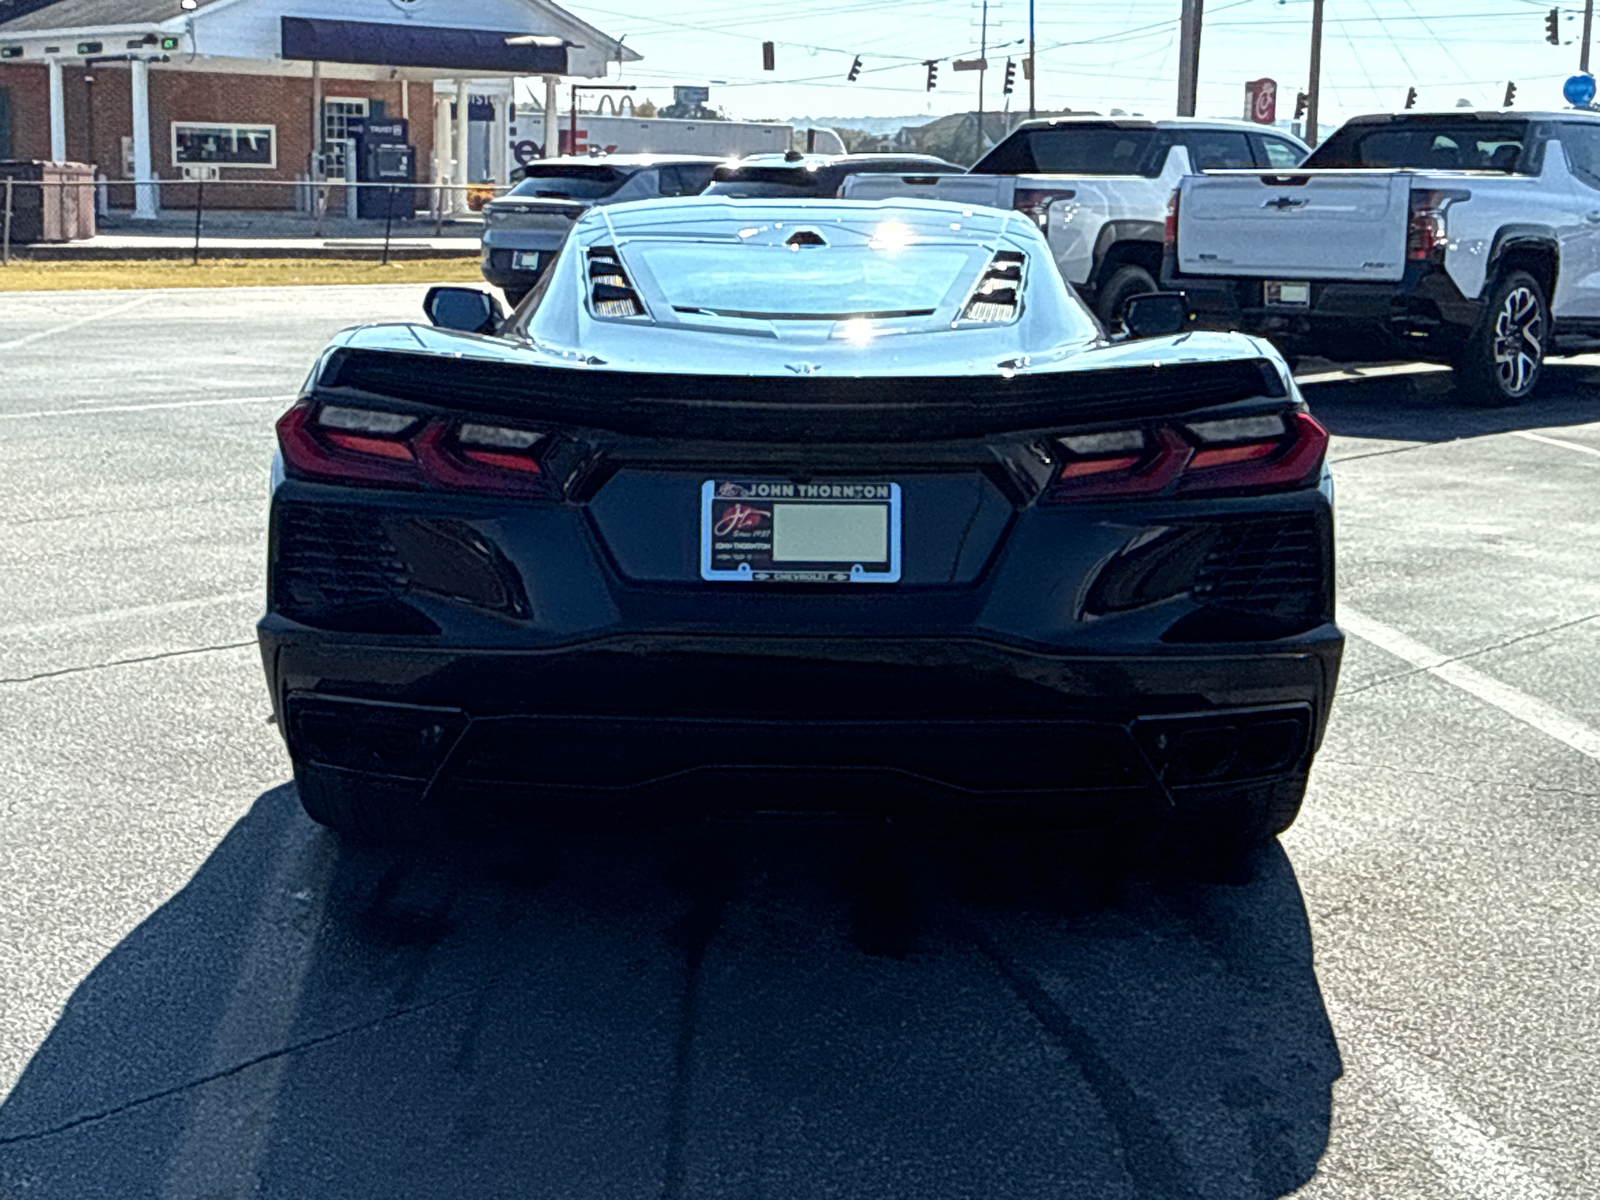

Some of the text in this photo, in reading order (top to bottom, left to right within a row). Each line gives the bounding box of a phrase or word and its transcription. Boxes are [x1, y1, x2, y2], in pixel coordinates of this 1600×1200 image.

[750, 483, 794, 497] JOHN
[796, 484, 889, 499] THORNTON
[774, 572, 829, 581] CHEVROLET
